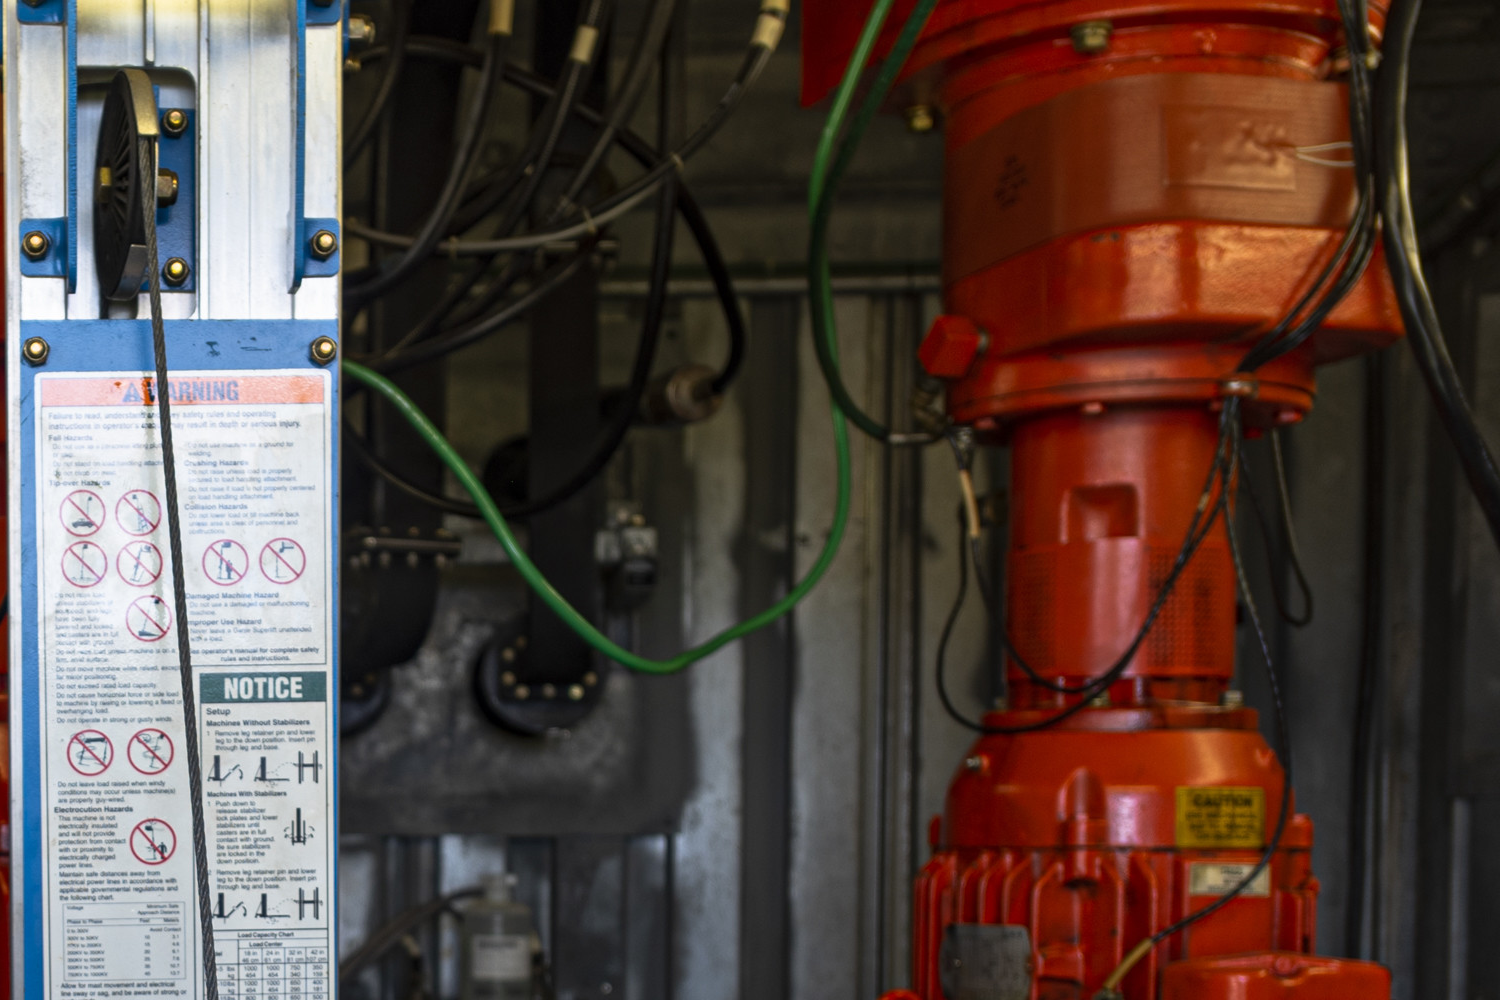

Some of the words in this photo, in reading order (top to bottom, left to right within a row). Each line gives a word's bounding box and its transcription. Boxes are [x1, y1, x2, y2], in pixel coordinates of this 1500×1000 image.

[186, 592, 219, 600] Damaged
[224, 676, 303, 700] NOTICE
[206, 708, 231, 716] Setup
[93, 830, 115, 838] provide
